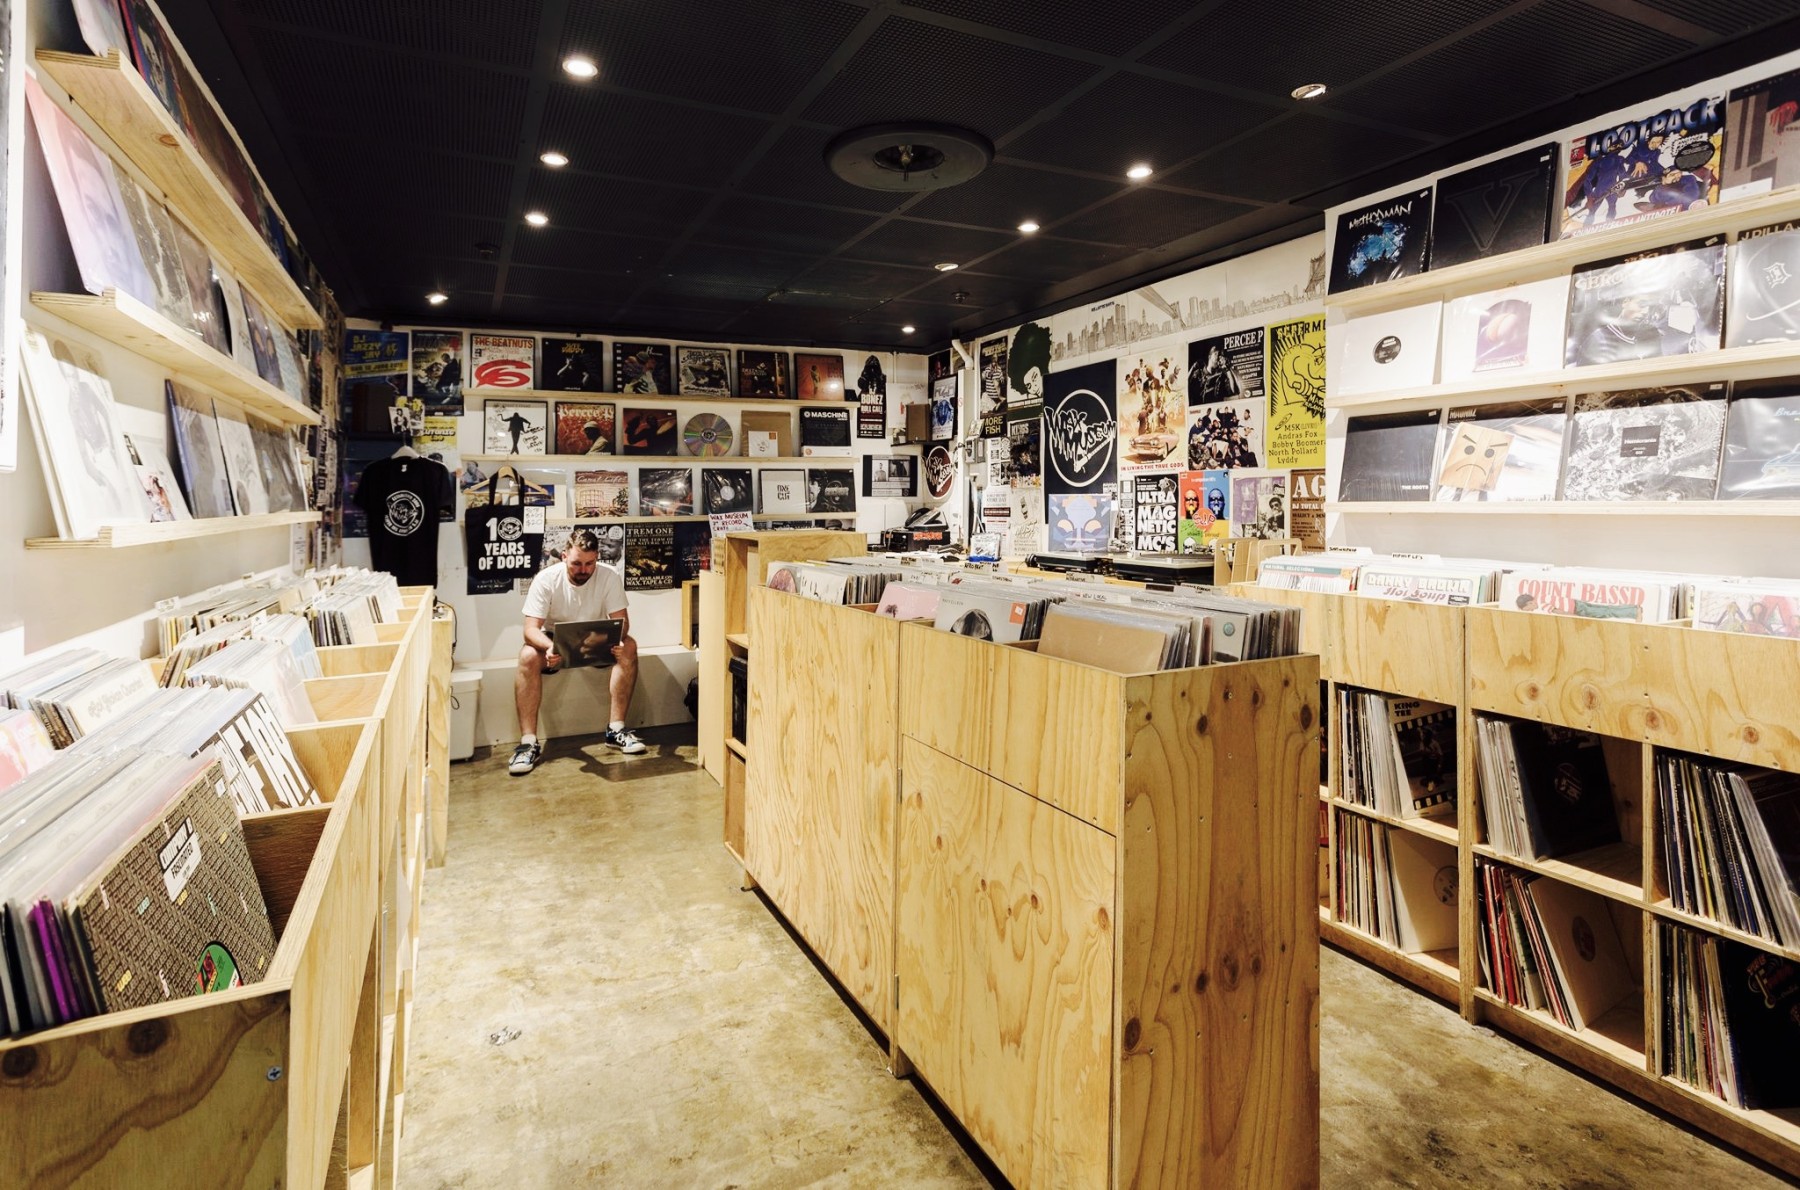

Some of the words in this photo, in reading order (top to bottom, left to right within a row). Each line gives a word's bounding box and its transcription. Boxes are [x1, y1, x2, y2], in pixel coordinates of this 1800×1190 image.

[1589, 101, 1719, 159] LOOTPACK
[474, 336, 490, 346] THE
[491, 337, 533, 349] BEATNUTS
[1223, 331, 1257, 350] PERCEE
[1258, 330, 1264, 343] P
[861, 393, 883, 405] BONEZ
[811, 411, 848, 419] MASCHINE
[984, 416, 1004, 426] MORE
[985, 426, 1001, 435] FISH
[1284, 423, 1301, 431] MSK
[1304, 430, 1318, 438] Fox
[1272, 441, 1294, 449] Bobby
[1268, 449, 1290, 457] North
[1291, 446, 1318, 455] Pollard
[1277, 456, 1299, 464] Lyddy
[1137, 491, 1176, 504] ULTRA
[724, 512, 749, 520] MUSEUM
[1137, 505, 1176, 520] MAG
[1137, 519, 1176, 534] NETIC
[483, 541, 525, 556] YEARS
[1137, 535, 1176, 551] MC'S
[478, 557, 495, 571] OF
[496, 554, 531, 570] DOPE
[1367, 573, 1413, 588] DANNY
[1518, 578, 1577, 602] COUNT
[1394, 701, 1420, 710] KING
[1394, 709, 1412, 717] TEE
